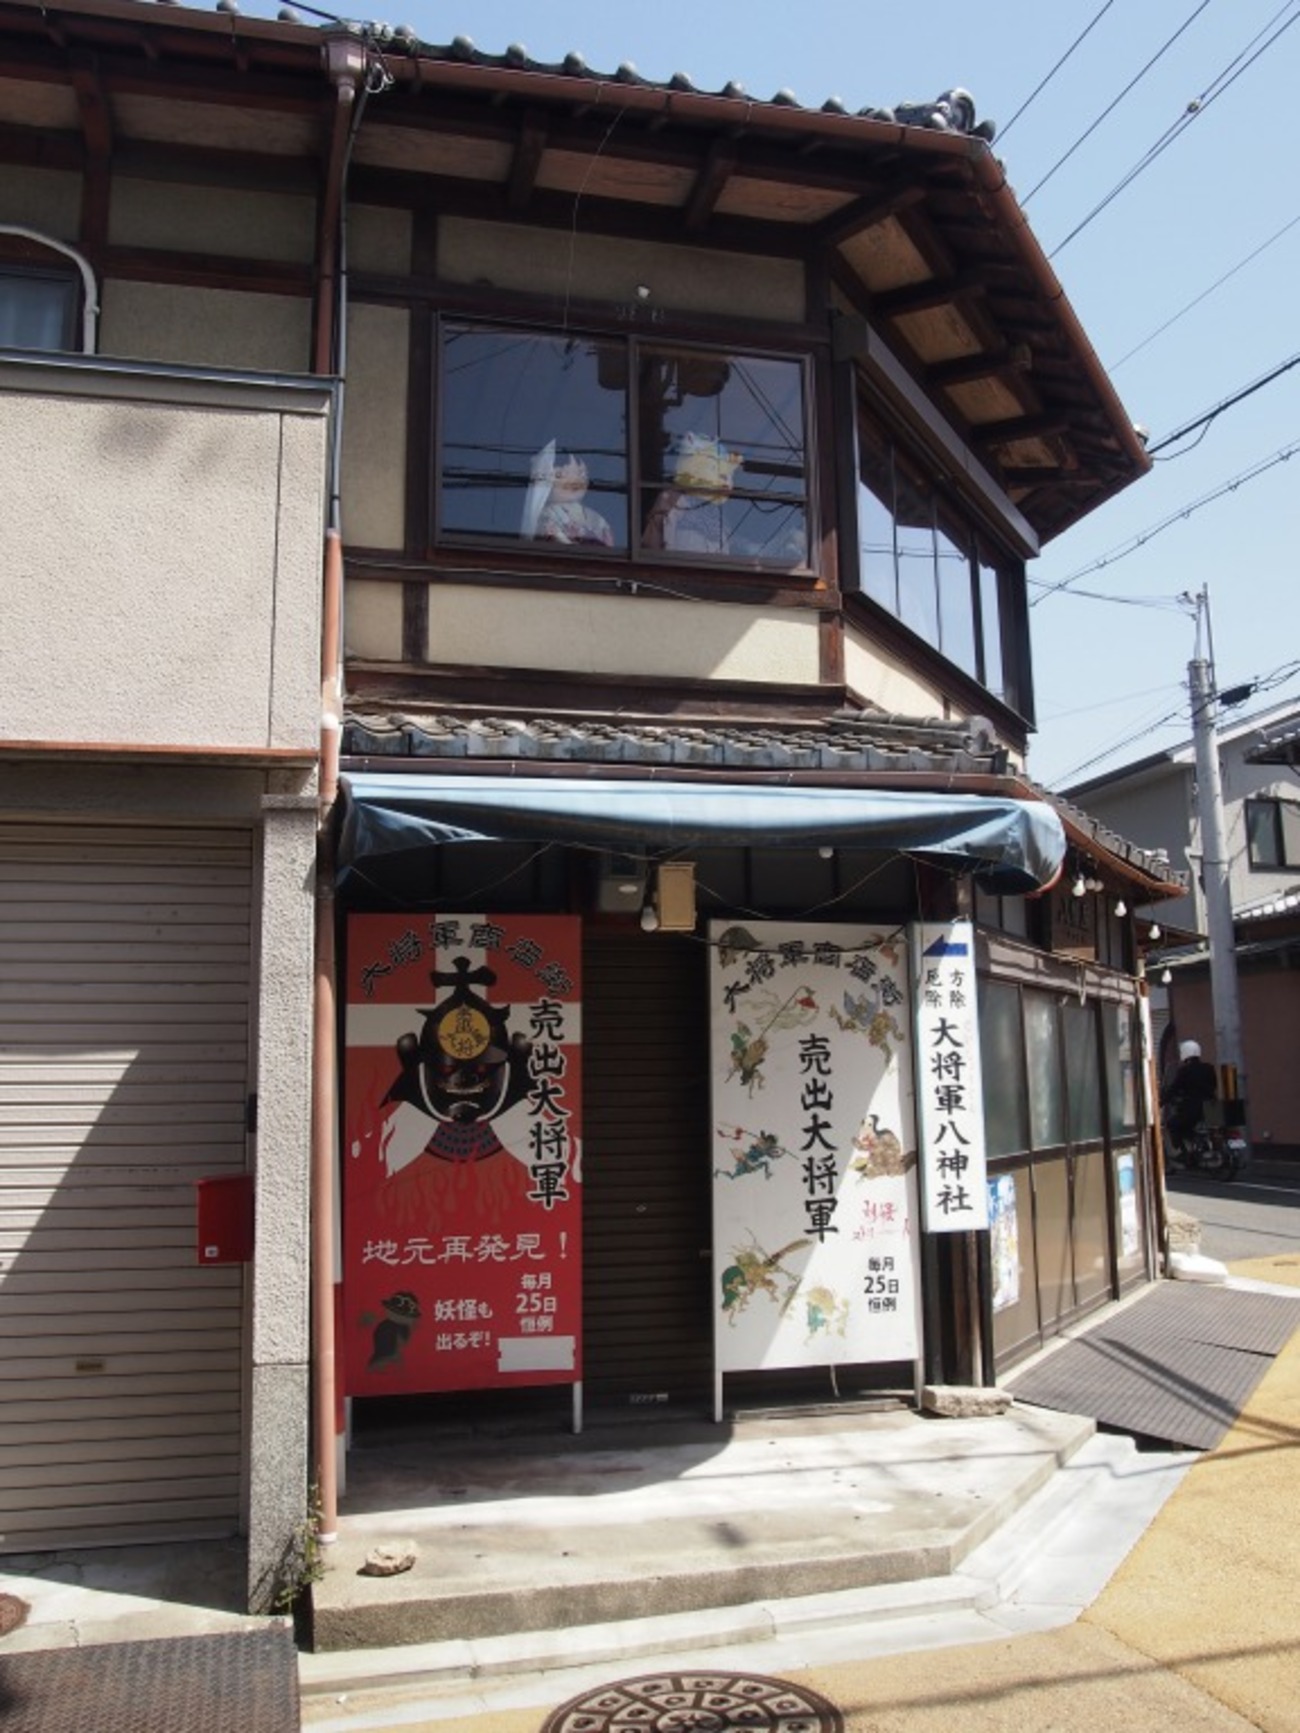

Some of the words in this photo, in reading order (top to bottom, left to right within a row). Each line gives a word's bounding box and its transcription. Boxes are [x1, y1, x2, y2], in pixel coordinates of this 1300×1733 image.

[723, 940, 904, 1014] 大将軍商店街
[527, 999, 569, 1208] 売出大将軍
[930, 1017, 974, 1215] 大将軍八神社
[797, 1033, 840, 1243] 売出大将軍
[361, 1231, 568, 1266] 地元再発見!
[867, 1256, 896, 1273] 毎月
[520, 1272, 552, 1290] 毎月
[862, 1276, 900, 1295] 25日
[434, 1299, 493, 1321] 妖怪も
[515, 1293, 558, 1314] 25日
[435, 1331, 492, 1351] 出るぞ!
